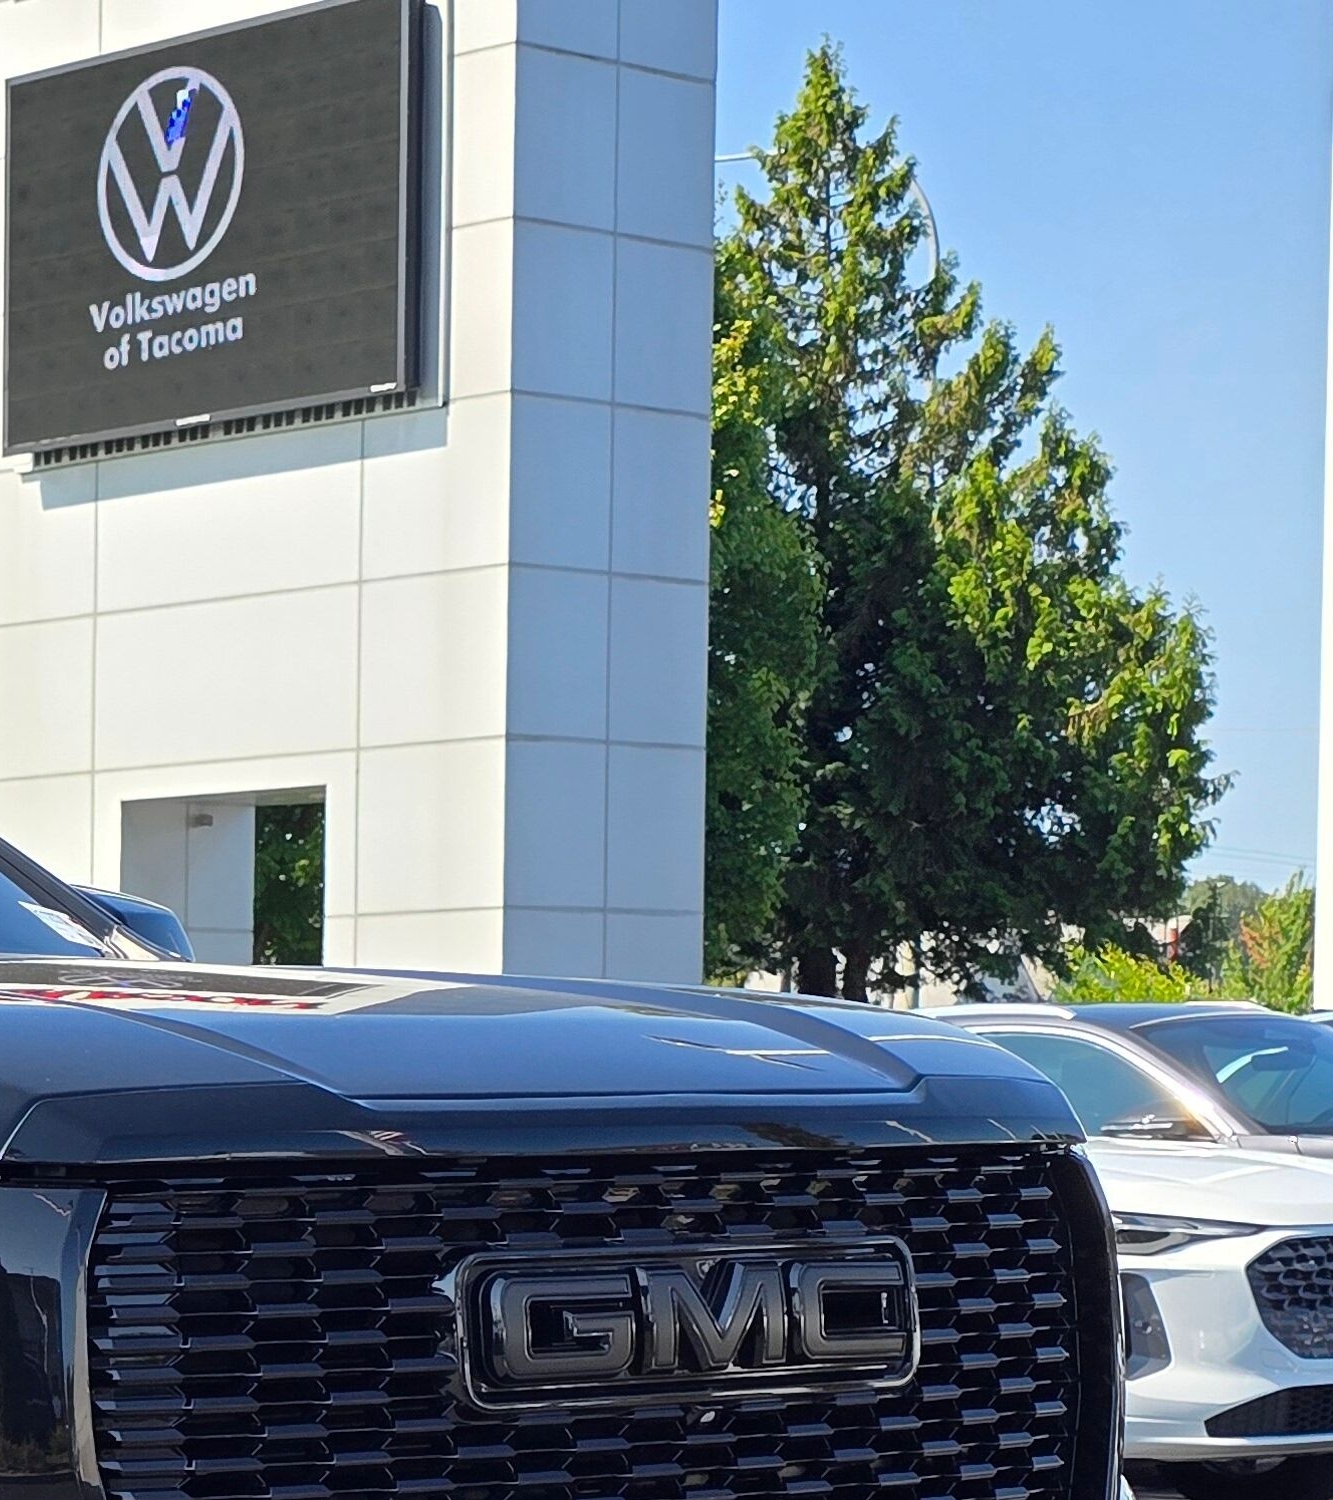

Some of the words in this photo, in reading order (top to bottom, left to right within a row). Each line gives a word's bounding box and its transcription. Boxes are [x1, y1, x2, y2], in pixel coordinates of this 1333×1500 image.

[89, 272, 257, 333] Volkswagen
[102, 332, 131, 371] of
[136, 316, 244, 362] Tacoma
[490, 1260, 909, 1380] GMC
